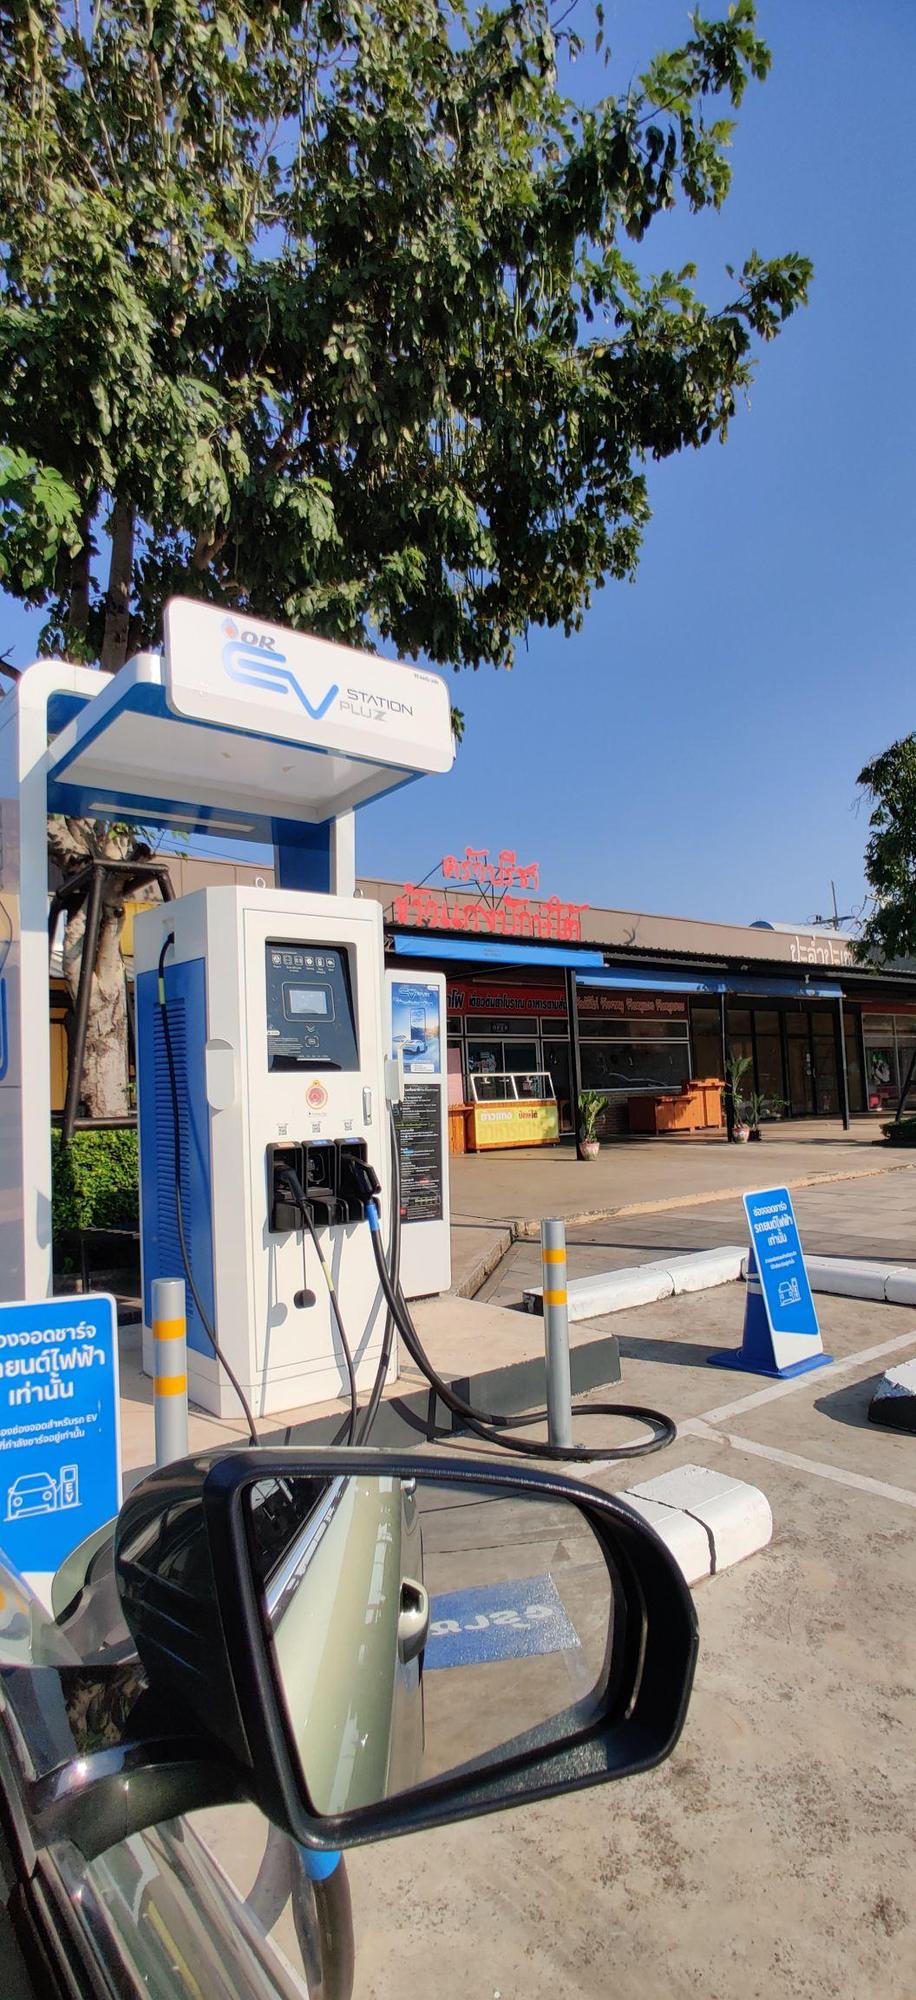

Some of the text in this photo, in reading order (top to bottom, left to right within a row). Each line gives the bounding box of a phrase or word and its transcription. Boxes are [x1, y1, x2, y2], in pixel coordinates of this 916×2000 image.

[241, 631, 276, 651] OR
[223, 641, 339, 720] EV
[339, 700, 387, 722] PLUZ
[346, 688, 414, 717] STATION
[753, 1200, 788, 1217] ช่องจอดชาร์จ
[754, 1213, 793, 1234] รถยนต์ไฟฟ้า
[767, 1228, 788, 1247] เท่านั้น
[0, 1344, 106, 1379] ยนต์ไฟฟ้า
[9, 1373, 74, 1406] เท่านั้น
[85, 1413, 98, 1424] EV
